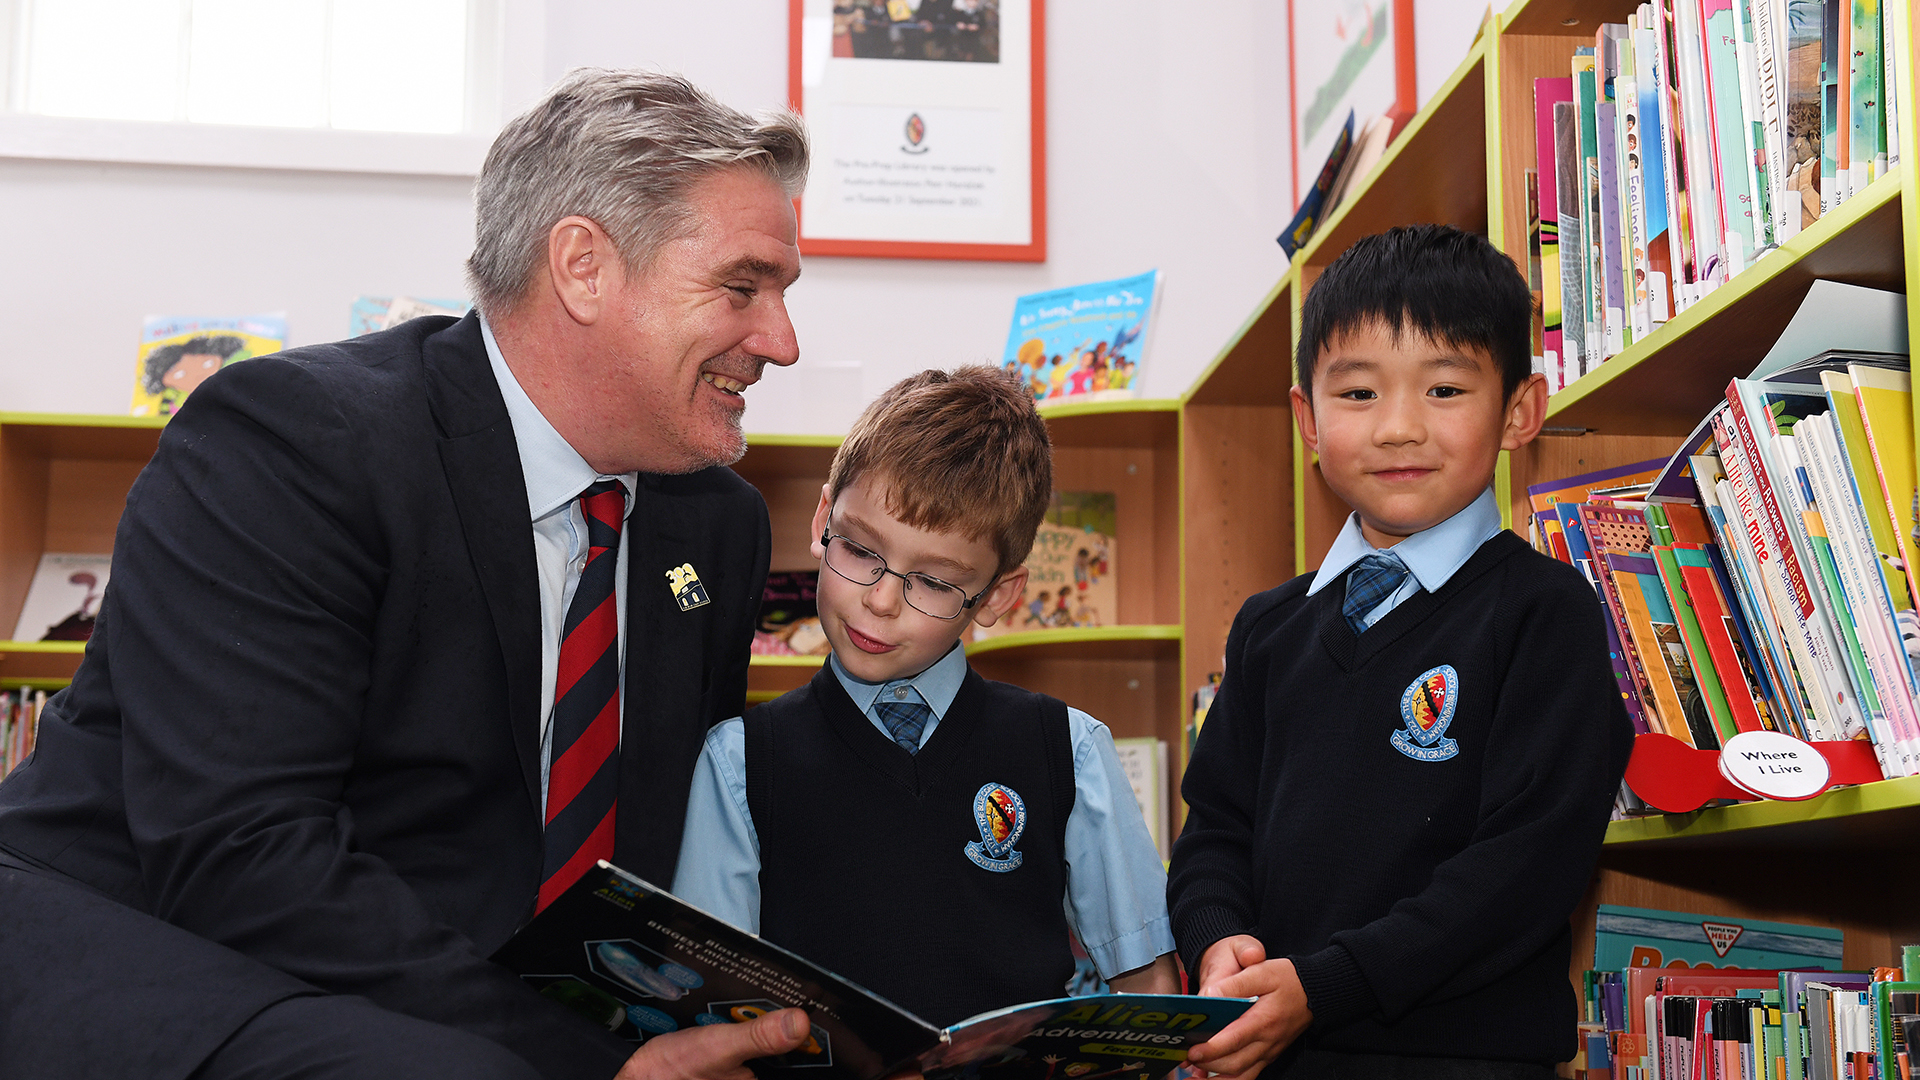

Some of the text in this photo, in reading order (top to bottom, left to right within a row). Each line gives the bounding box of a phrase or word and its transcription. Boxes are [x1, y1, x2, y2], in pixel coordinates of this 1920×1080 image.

[1723, 454, 1735, 467] A
[1727, 463, 1743, 492] life
[1736, 488, 1753, 520] like
[1739, 416, 1762, 476] Questions
[1763, 487, 1785, 542] Answers
[1786, 553, 1808, 608] Racism
[1747, 518, 1769, 565] mine
[1756, 503, 1765, 521] Just
[1763, 519, 1772, 540] Like
[1770, 539, 1778, 554] Me
[1795, 508, 1812, 551] GEOGRAPHY
[1844, 488, 1862, 534] GEOGRAPHY
[1867, 560, 1881, 591] LOCAL
[1776, 557, 1817, 659] A School Like Mine
[1768, 571, 1778, 594] How
[1775, 594, 1791, 632] children
[1788, 629, 1798, 648] live
[1796, 649, 1810, 680] around
[1814, 699, 1827, 727] world
[1406, 681, 1420, 696] BLUE
[1419, 668, 1440, 681] COAT
[1408, 720, 1420, 736] 1722
[1428, 694, 1455, 739] BIRMINGHAM
[1392, 736, 1458, 759] GROW IN GRACE
[1740, 752, 1798, 760] Where
[1758, 764, 1802, 774] I Live
[985, 834, 995, 849] 1722
[967, 848, 989, 866] GROW
[998, 858, 1021, 870] GRACE
[647, 919, 703, 950] BIGGEST
[704, 948, 807, 1000] micro-adventure
[808, 998, 830, 1012] yet
[696, 952, 718, 967] out
[719, 965, 736, 975] of
[736, 971, 759, 986] this
[705, 938, 802, 988] Blast off on the
[1049, 1003, 1209, 1030] Alien
[1872, 997, 1881, 1057] PRECIOUS
[1023, 1027, 1185, 1045] Adventures
[1102, 1045, 1166, 1057] Fact File
